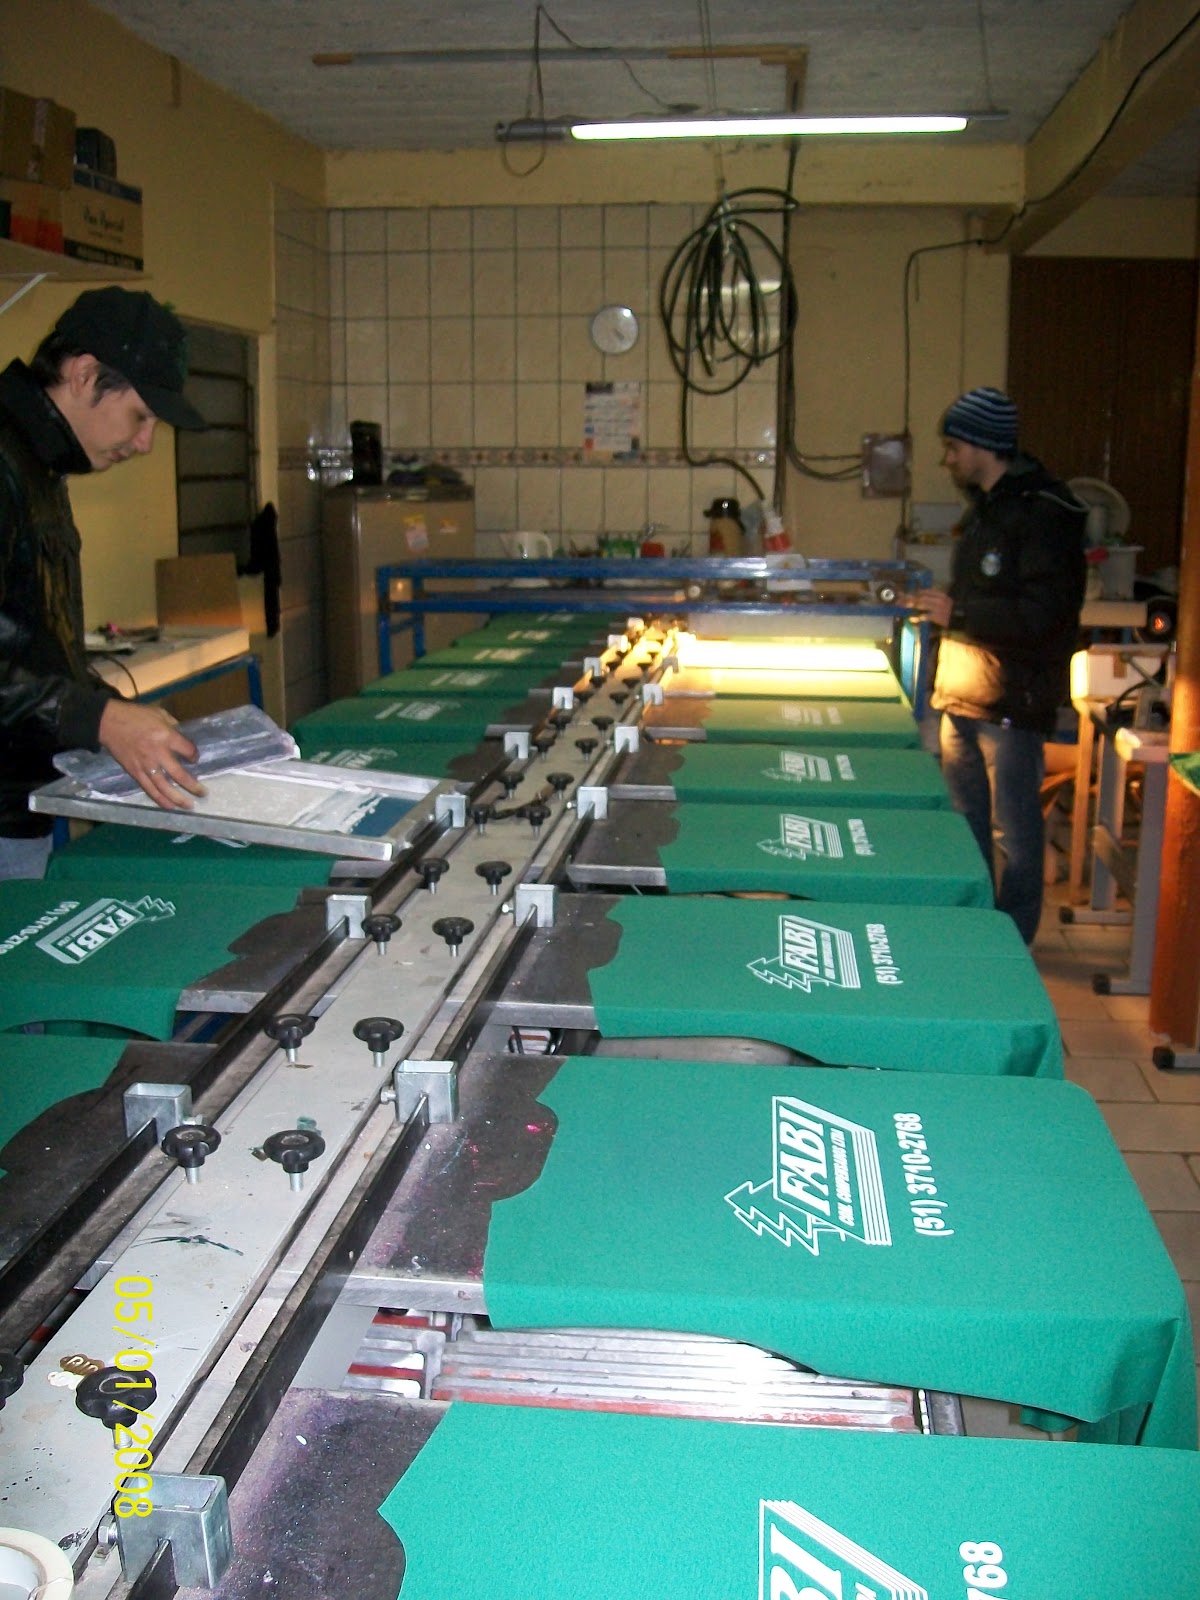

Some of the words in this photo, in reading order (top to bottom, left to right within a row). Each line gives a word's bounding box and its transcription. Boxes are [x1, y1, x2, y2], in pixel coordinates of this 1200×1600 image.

[66, 908, 136, 958] FABI
[784, 919, 820, 975] FABI
[865, 923, 894, 966] 3710-2768
[874, 966, 904, 985] (51)
[779, 1105, 831, 1216] FABI
[893, 1112, 938, 1195] 3710-2768
[909, 1199, 955, 1236] (51)
[958, 1540, 1009, 1600] 68
